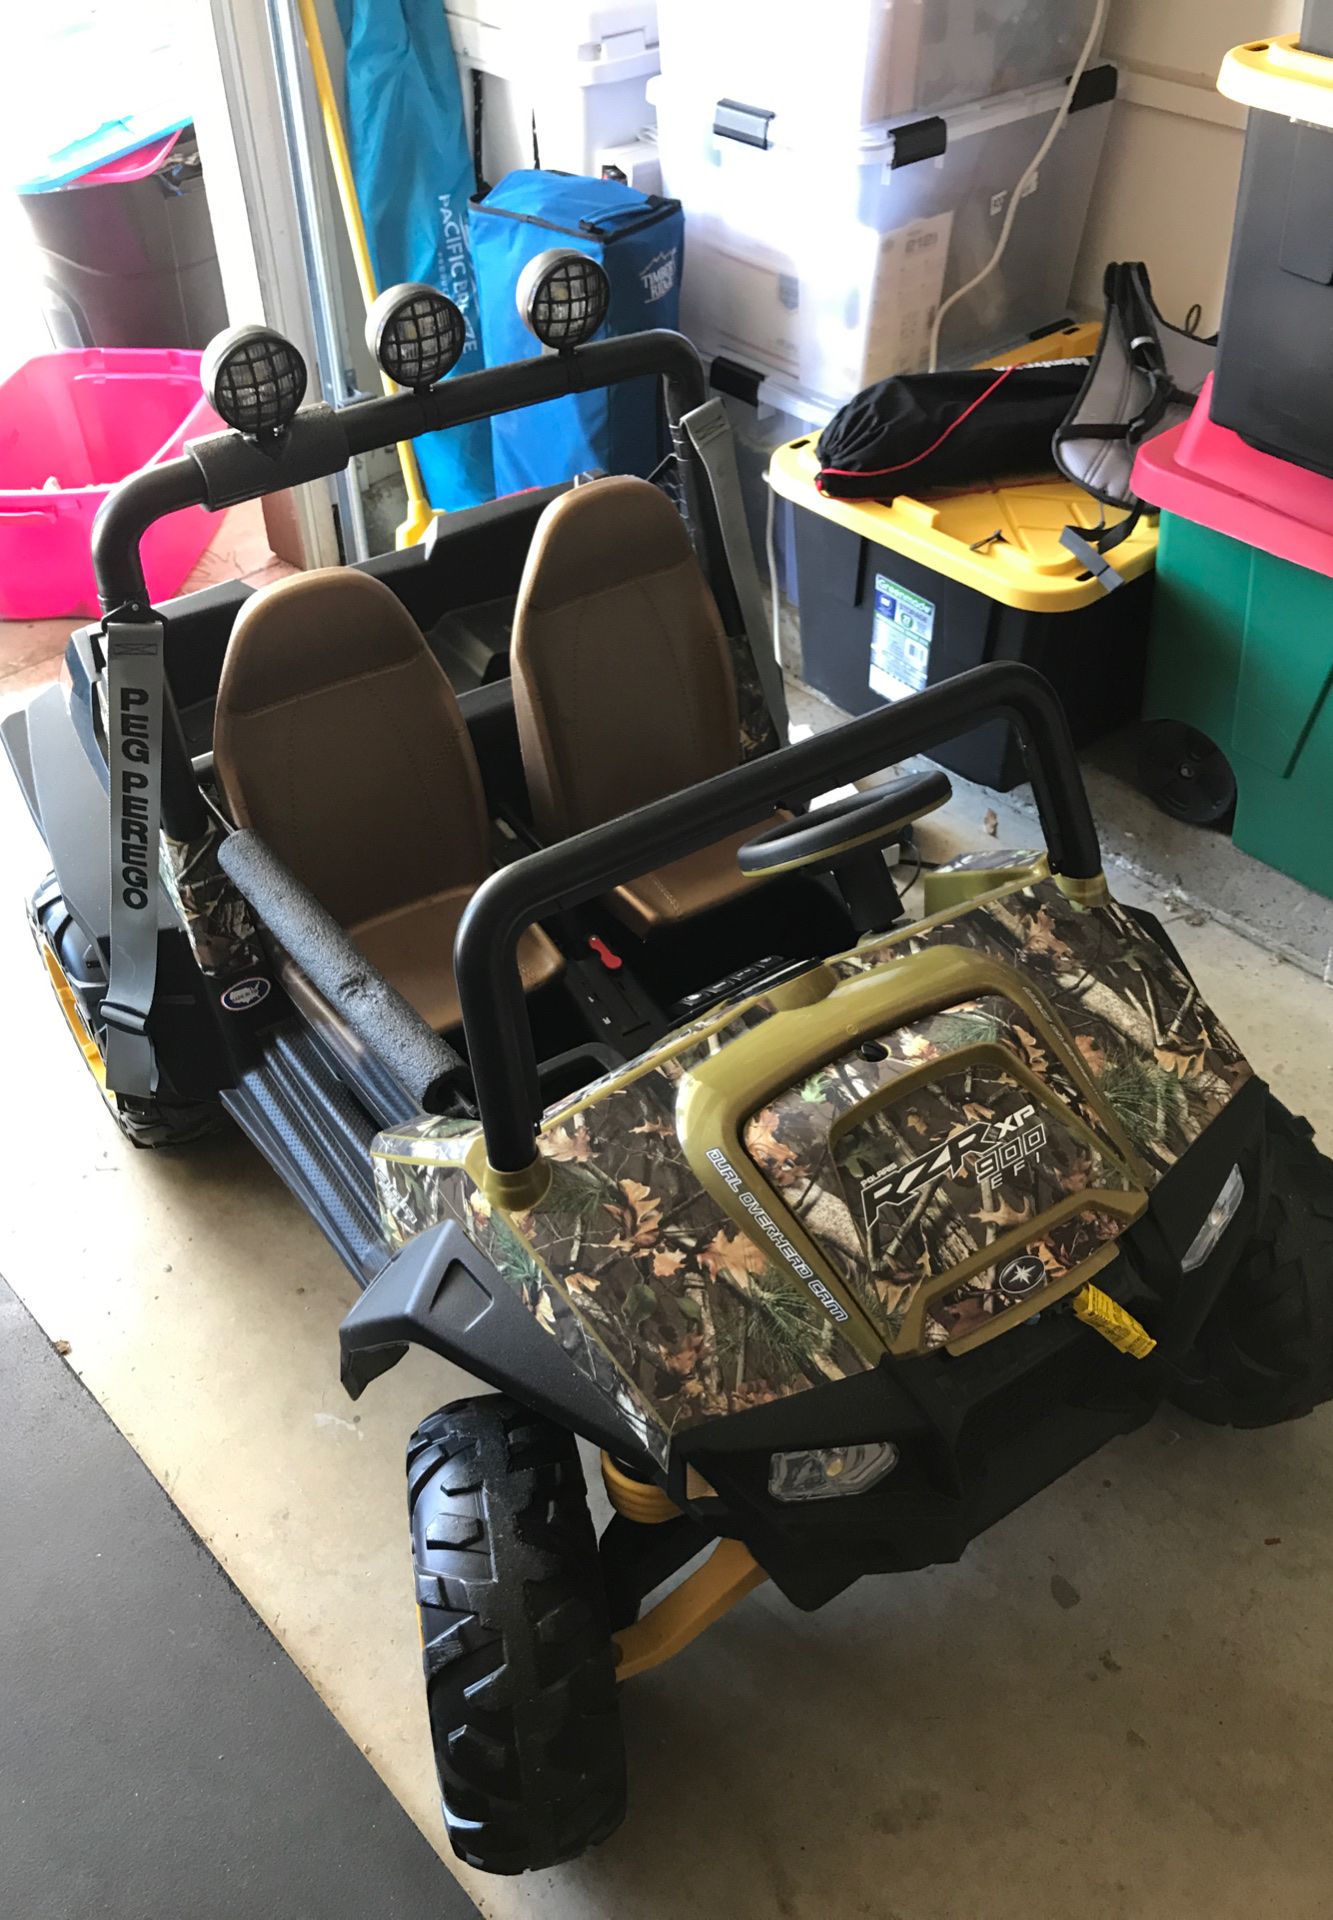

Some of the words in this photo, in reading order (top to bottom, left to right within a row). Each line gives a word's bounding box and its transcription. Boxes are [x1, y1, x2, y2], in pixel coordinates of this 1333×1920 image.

[438, 194, 467, 279] PACIFIC
[453, 279, 478, 354] BRZE
[120, 687, 149, 764] PEG
[120, 770, 149, 910] PEREGO
[974, 1123, 1047, 1184] 900
[993, 1104, 1036, 1139] XP
[860, 1162, 898, 1188] POLARIS
[860, 1121, 1002, 1231] RZR
[706, 1146, 743, 1193] DUAL
[739, 1191, 814, 1281] OVERHEAD
[808, 1279, 849, 1322] CAM
